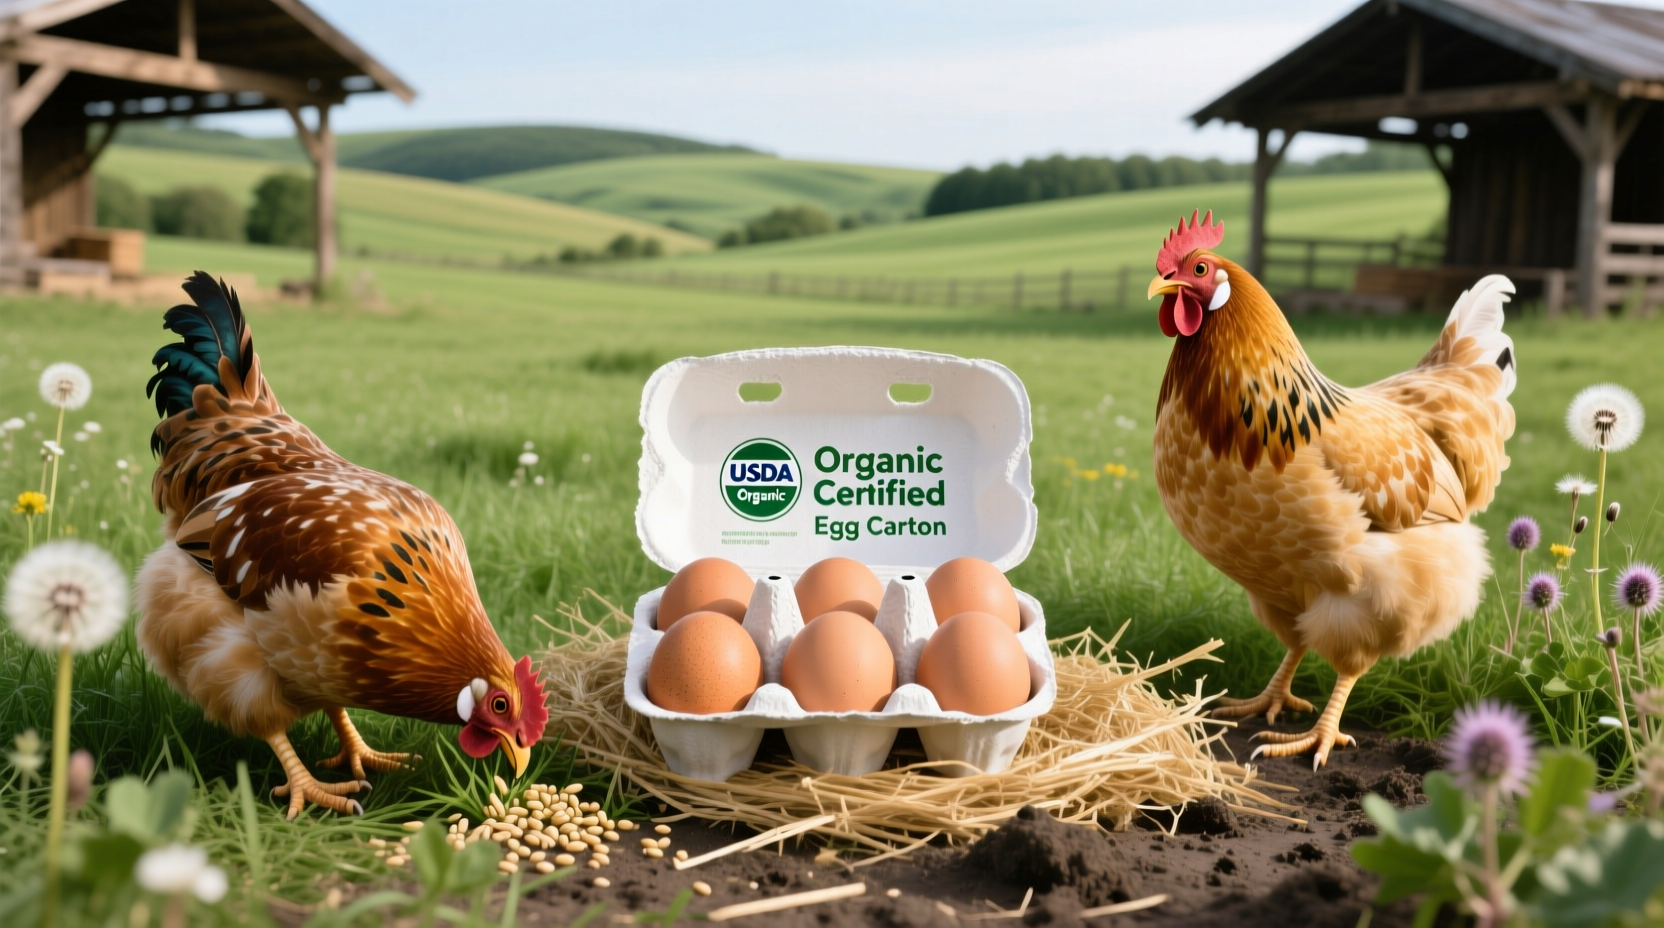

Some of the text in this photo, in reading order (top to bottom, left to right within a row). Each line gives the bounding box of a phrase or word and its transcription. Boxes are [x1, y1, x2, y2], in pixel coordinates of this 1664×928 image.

[730, 463, 794, 482] USDA
[814, 445, 943, 481] Organic
[813, 479, 945, 506] Certified
[815, 516, 947, 541] Egg Carton
